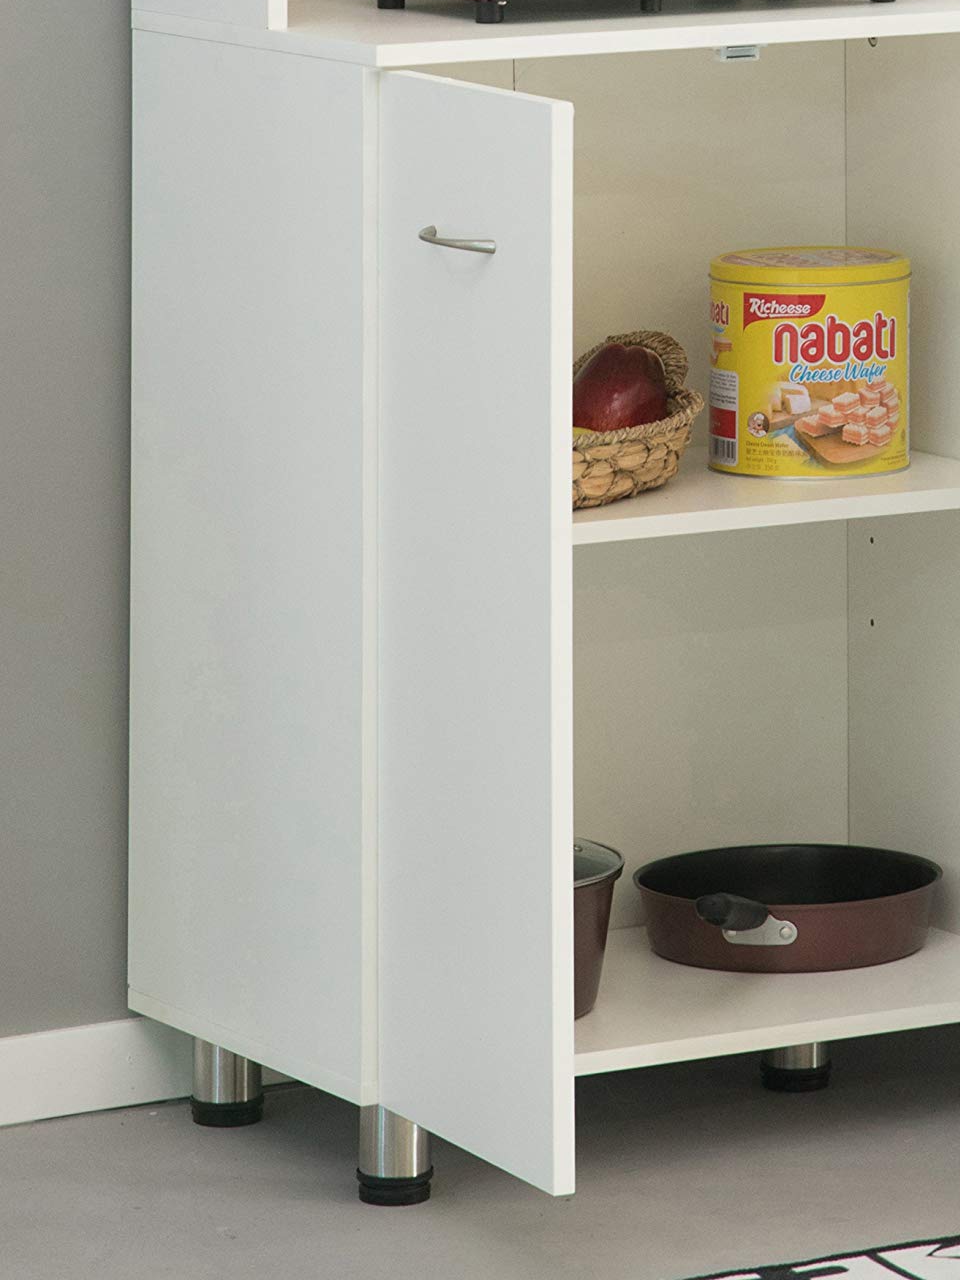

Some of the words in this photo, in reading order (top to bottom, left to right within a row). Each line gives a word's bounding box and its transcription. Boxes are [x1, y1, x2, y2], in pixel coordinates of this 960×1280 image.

[749, 297, 812, 317] Richeese
[774, 310, 896, 364] nabati
[789, 363, 841, 383] Cheese
[843, 361, 887, 384] Wafer
